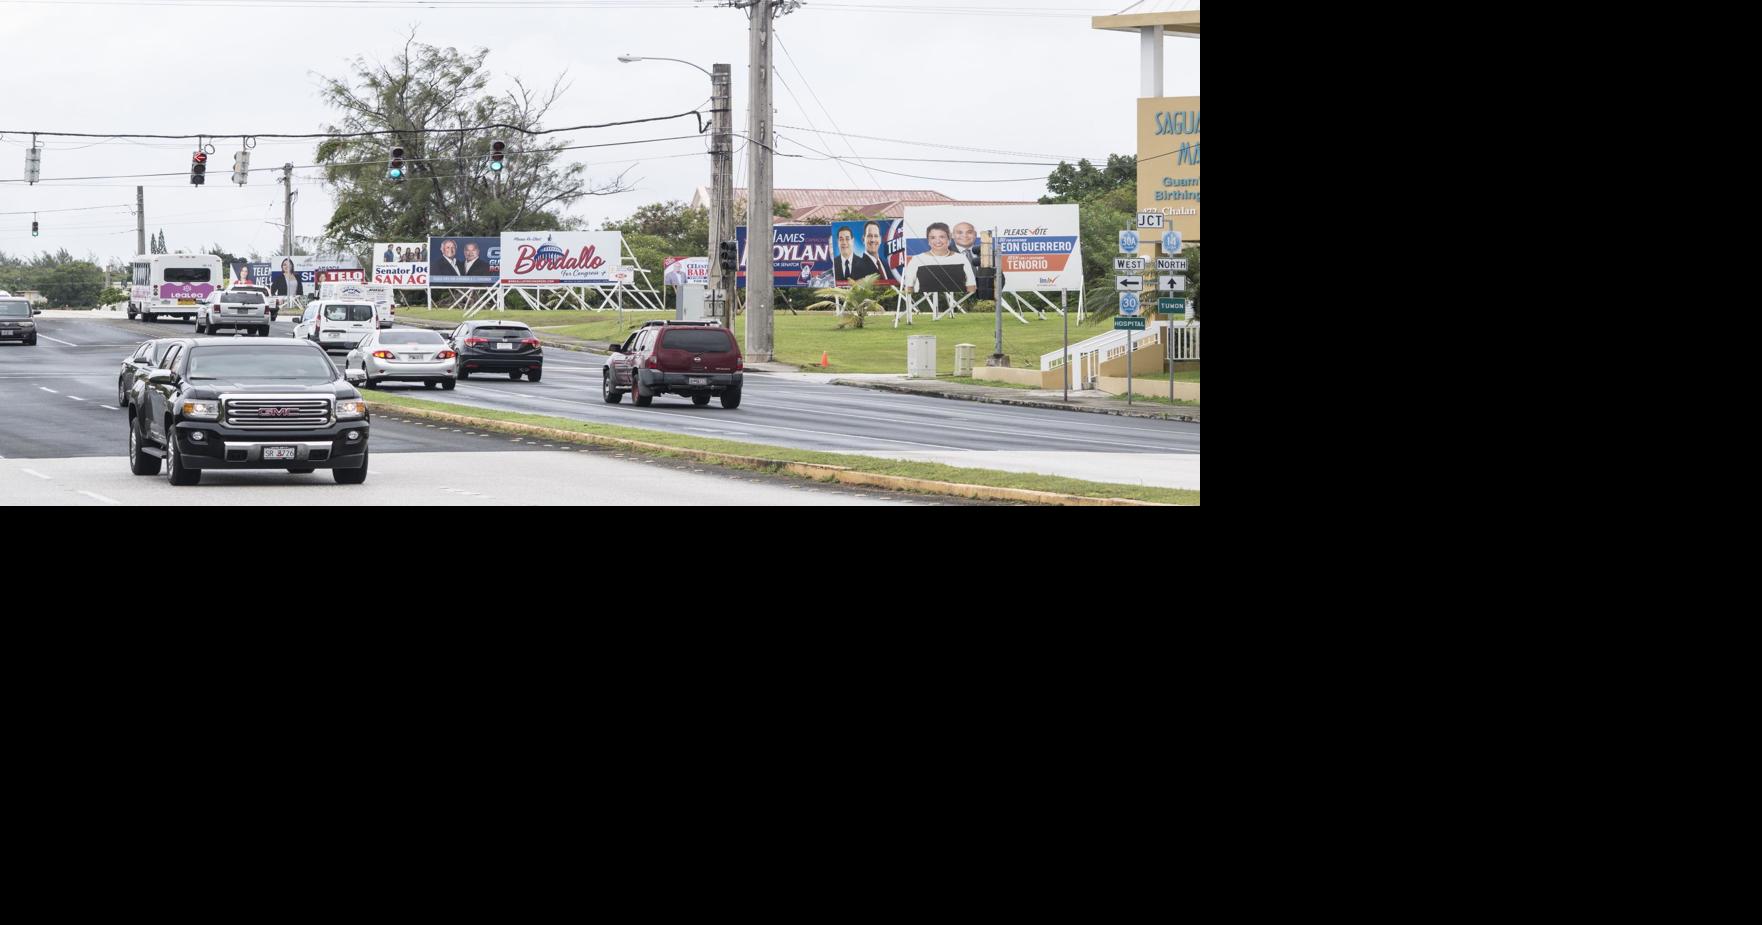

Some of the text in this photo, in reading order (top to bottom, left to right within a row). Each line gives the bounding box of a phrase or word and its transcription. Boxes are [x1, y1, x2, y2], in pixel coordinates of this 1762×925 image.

[1155, 190, 1200, 202] Birthing
[1162, 206, 1196, 216] Chalan
[1139, 215, 1162, 226] JCT
[1122, 236, 1136, 245] 30A
[1000, 241, 1072, 252] EON GUERRERO
[513, 244, 606, 275] Bordallo
[1117, 260, 1142, 268] WEST
[1157, 260, 1186, 268] NORTH
[1007, 260, 1048, 270] TENORIO
[375, 267, 410, 275] Senator
[328, 272, 363, 280] TELO
[375, 275, 403, 284] SAN
[407, 274, 427, 284] AG
[1123, 300, 1136, 308] 30
[258, 407, 300, 416] GMC
